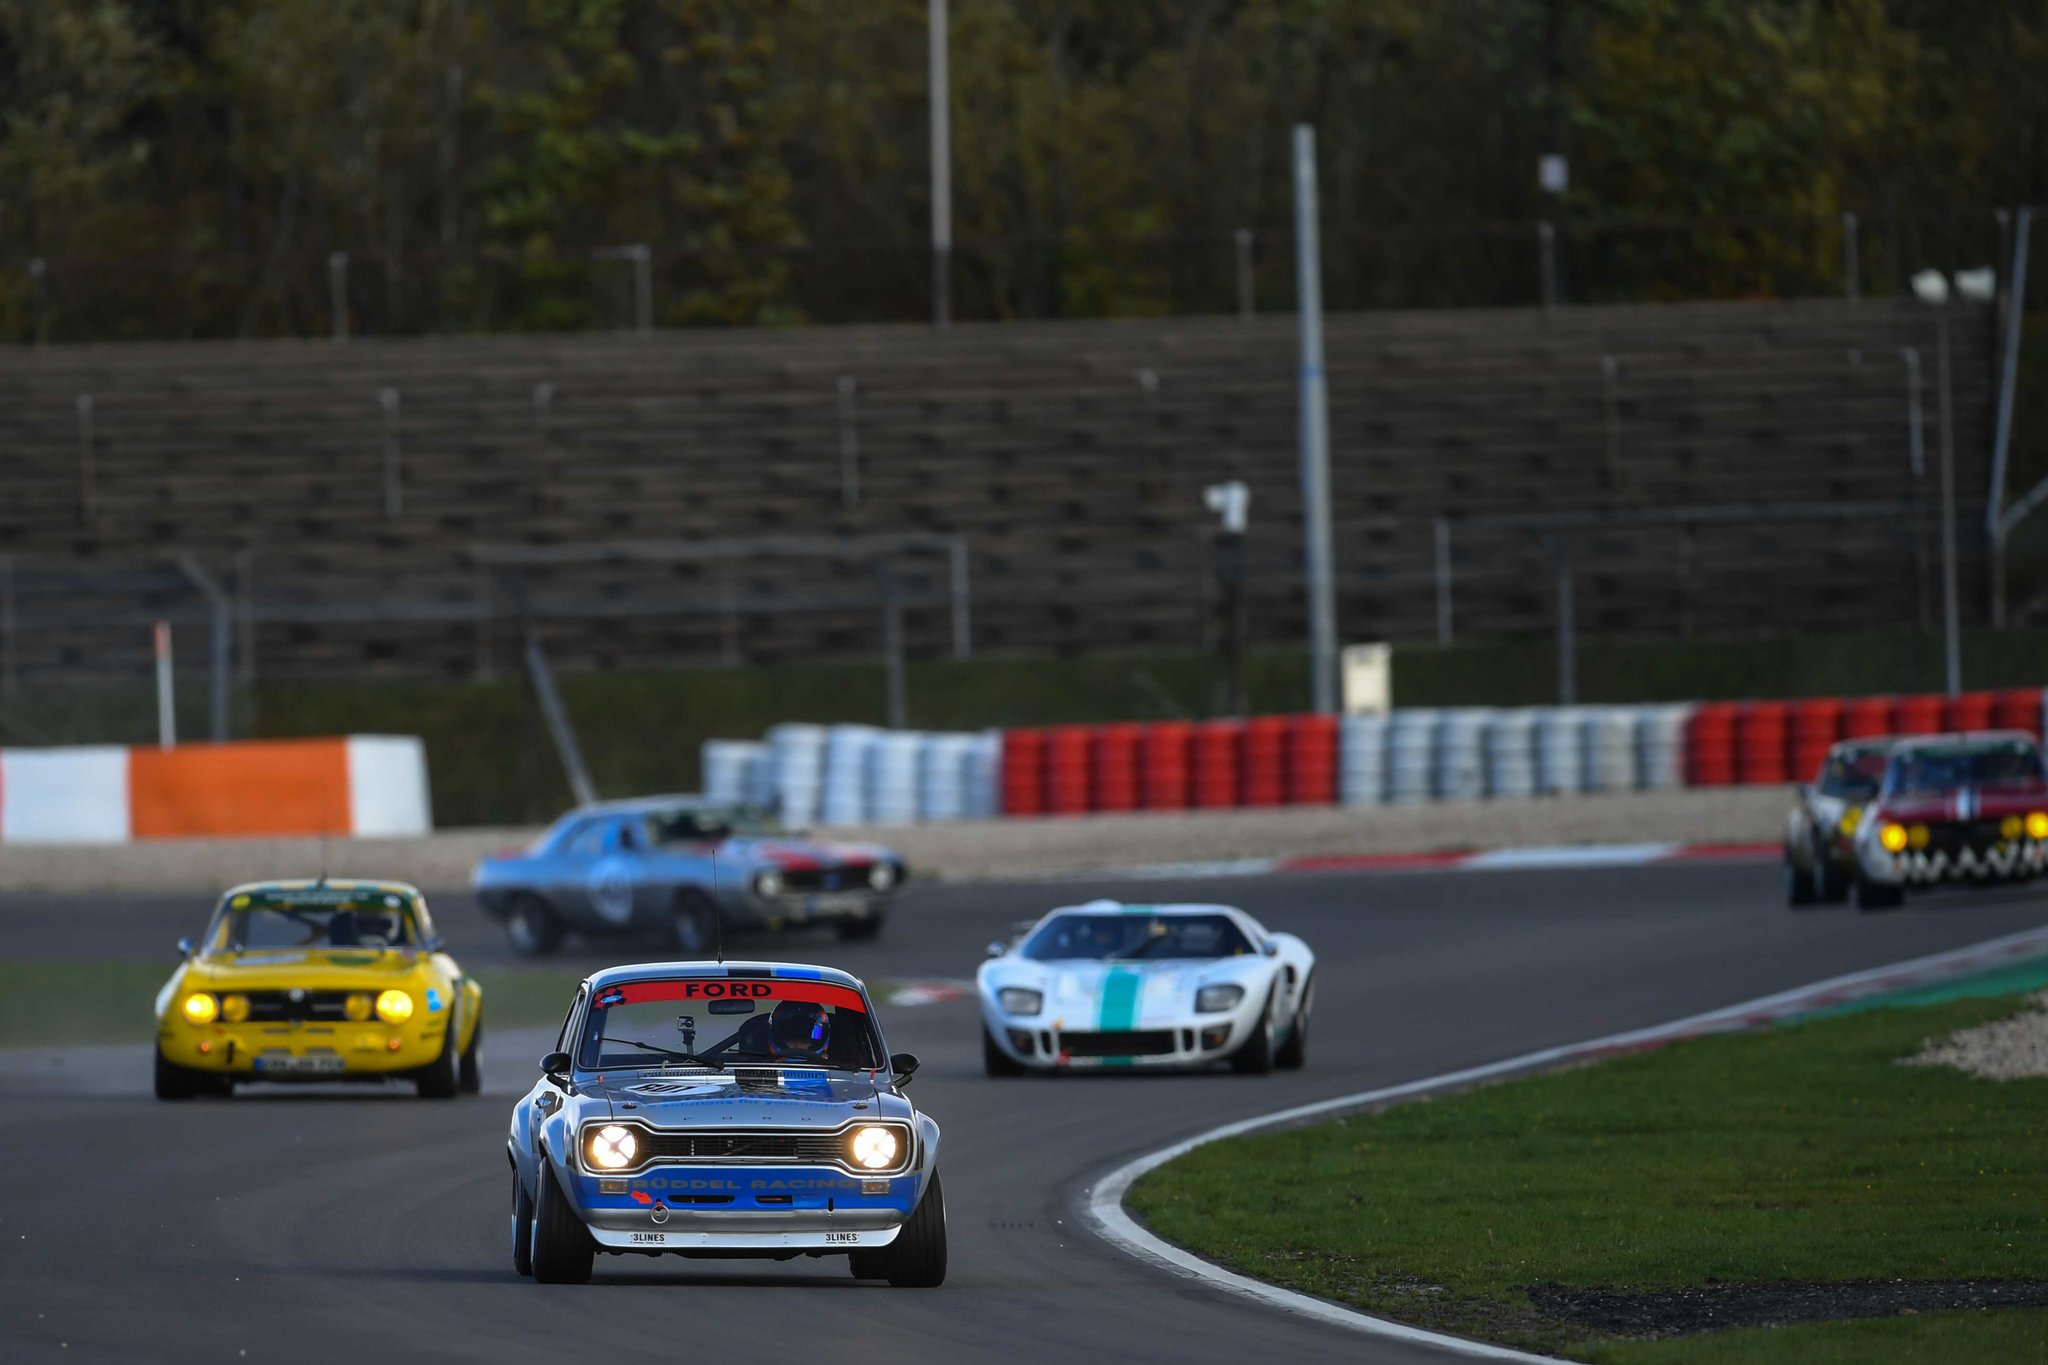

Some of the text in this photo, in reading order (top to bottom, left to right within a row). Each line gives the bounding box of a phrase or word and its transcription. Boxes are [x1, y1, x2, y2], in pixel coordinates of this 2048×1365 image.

[685, 983, 772, 997] FORD
[751, 1179, 857, 1189] RACING
[633, 1233, 665, 1242] 3LINES
[825, 1233, 857, 1241] 3LINES
